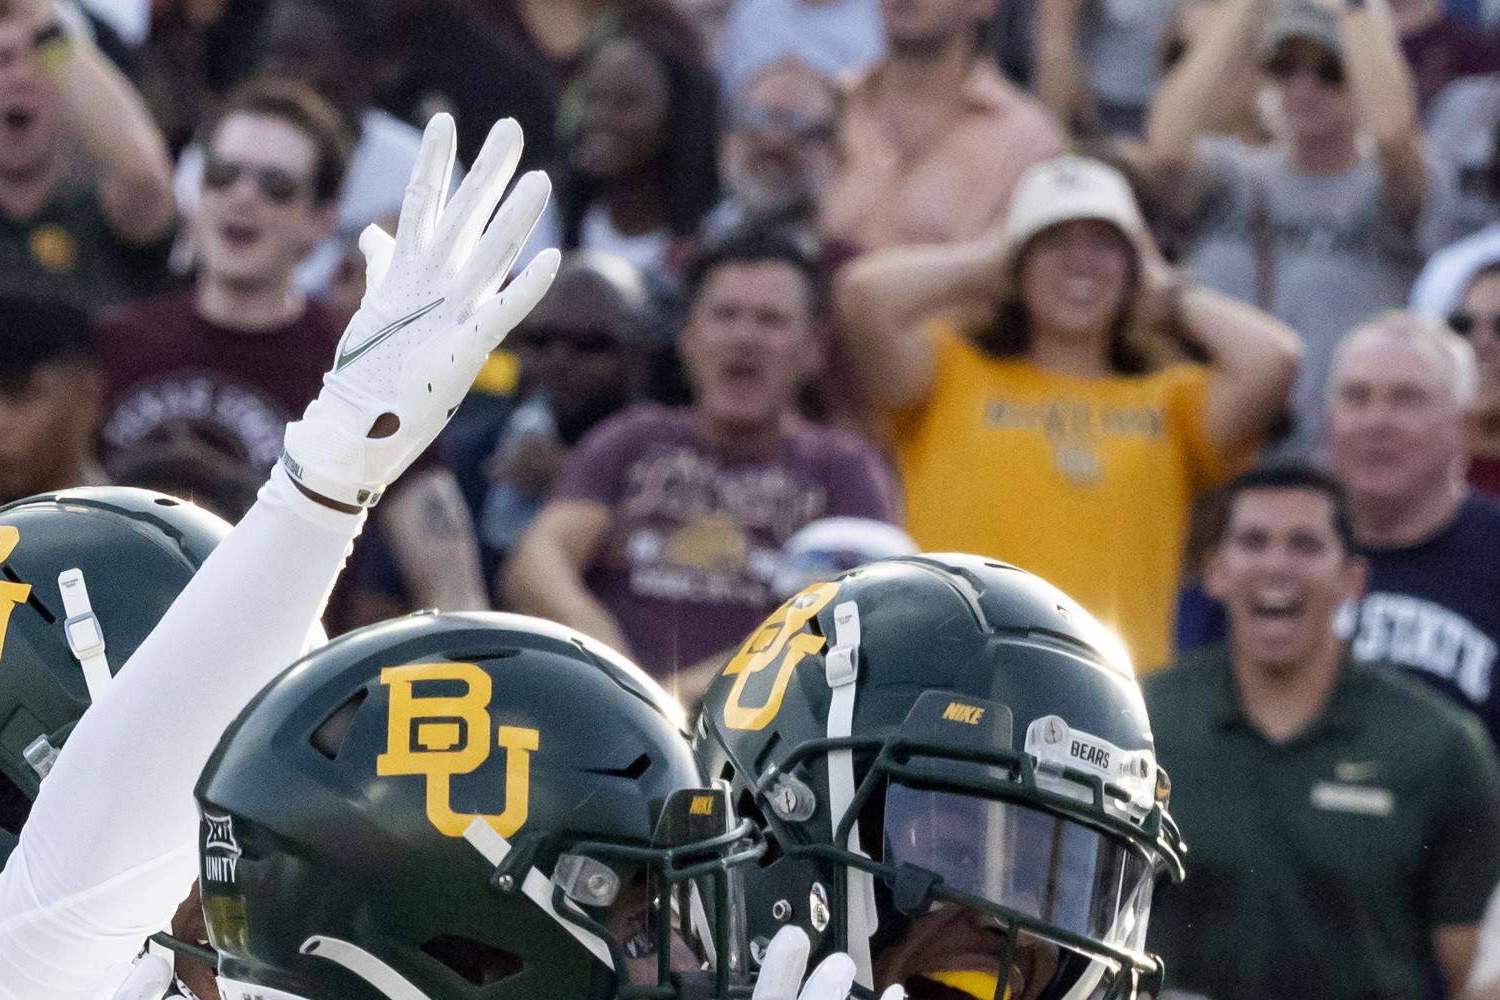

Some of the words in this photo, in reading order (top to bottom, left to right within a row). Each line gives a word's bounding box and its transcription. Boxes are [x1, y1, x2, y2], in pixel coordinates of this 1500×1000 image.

[723, 581, 842, 731] BU
[942, 702, 985, 725] NIKE
[376, 662, 539, 839] BU
[1069, 740, 1111, 769] BEARS
[205, 855, 238, 883] UNITY
